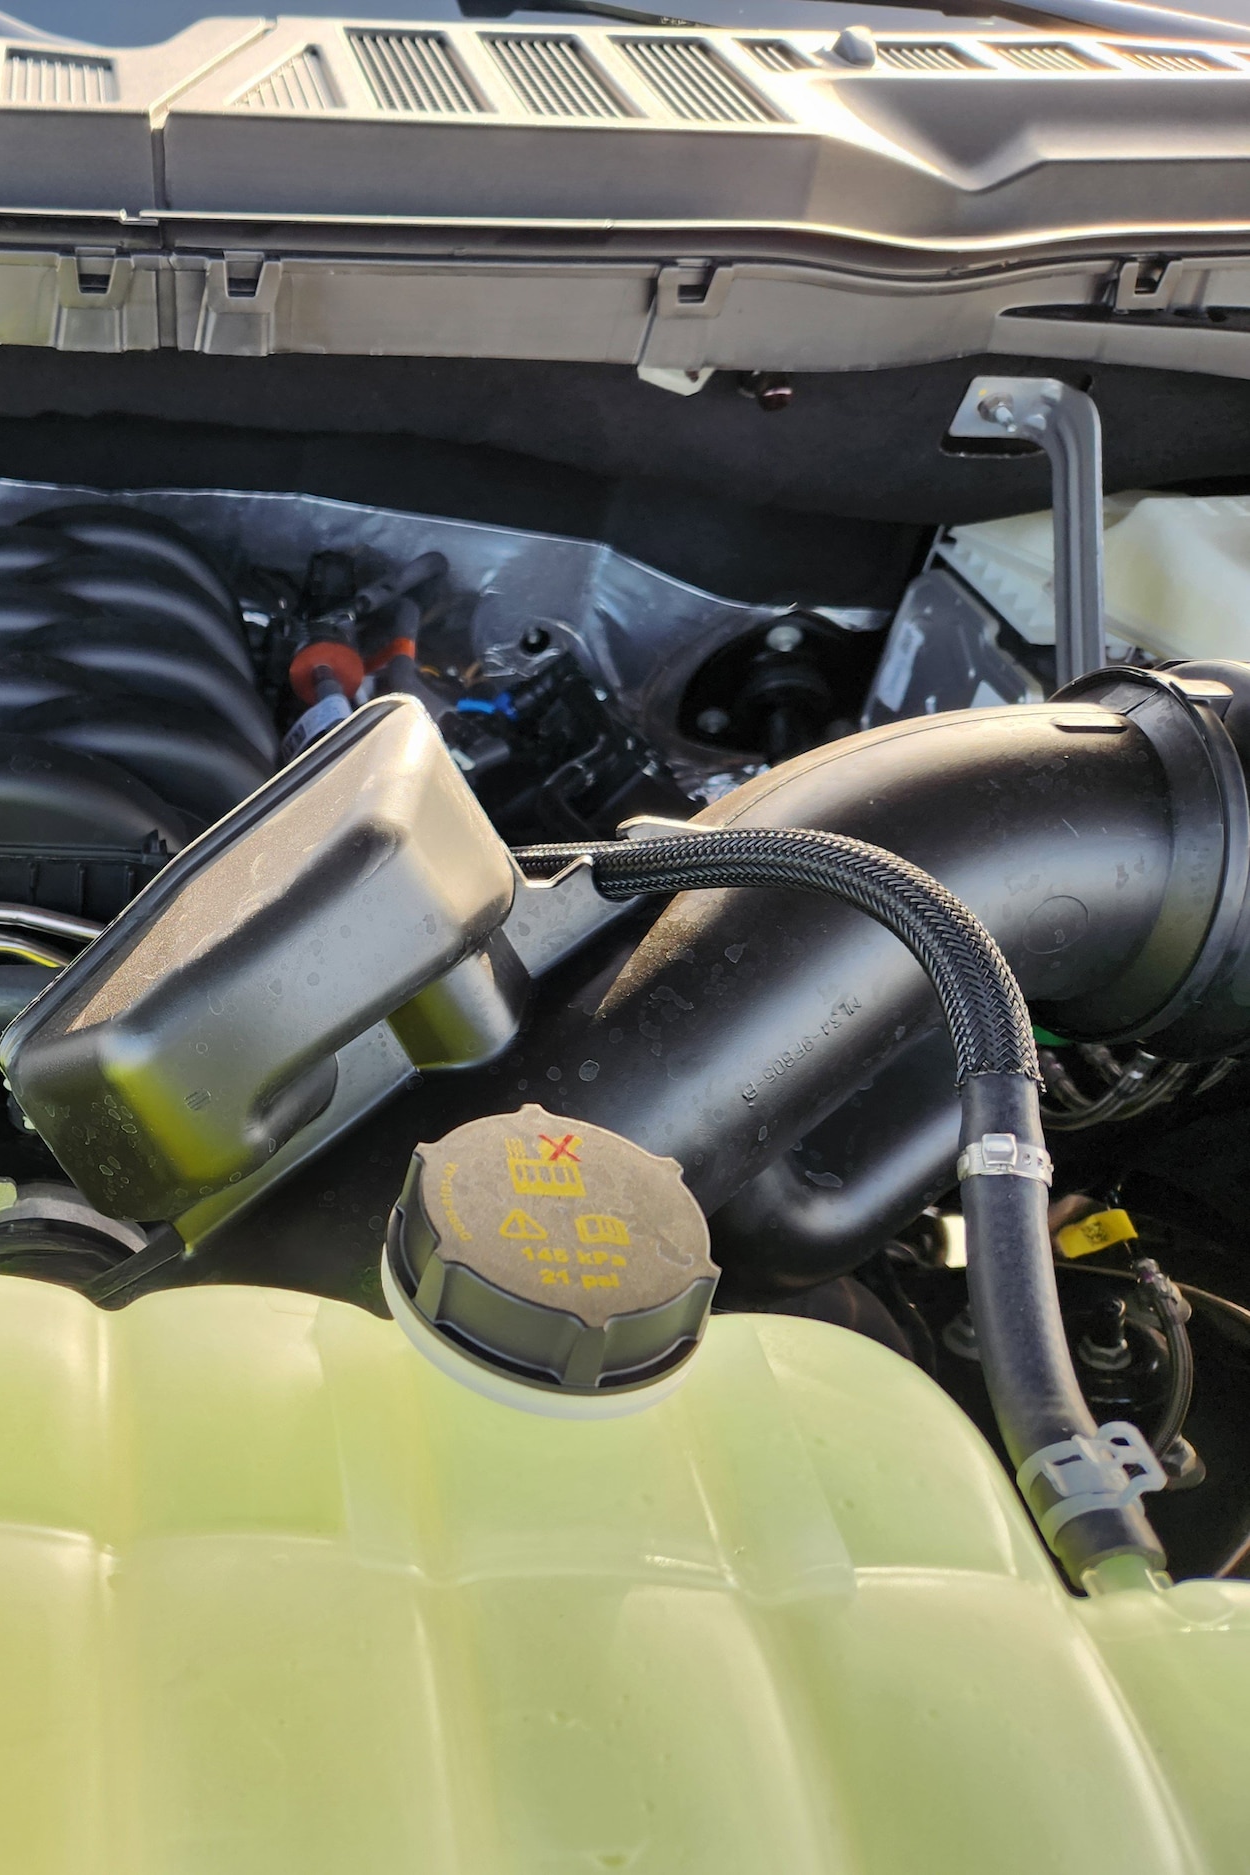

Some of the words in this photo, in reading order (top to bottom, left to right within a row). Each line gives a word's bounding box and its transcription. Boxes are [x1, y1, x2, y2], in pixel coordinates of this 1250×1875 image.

[521, 1246, 569, 1264] 145
[576, 1249, 627, 1268] kPa
[539, 1268, 570, 1286] 21
[580, 1272, 620, 1292] psi
